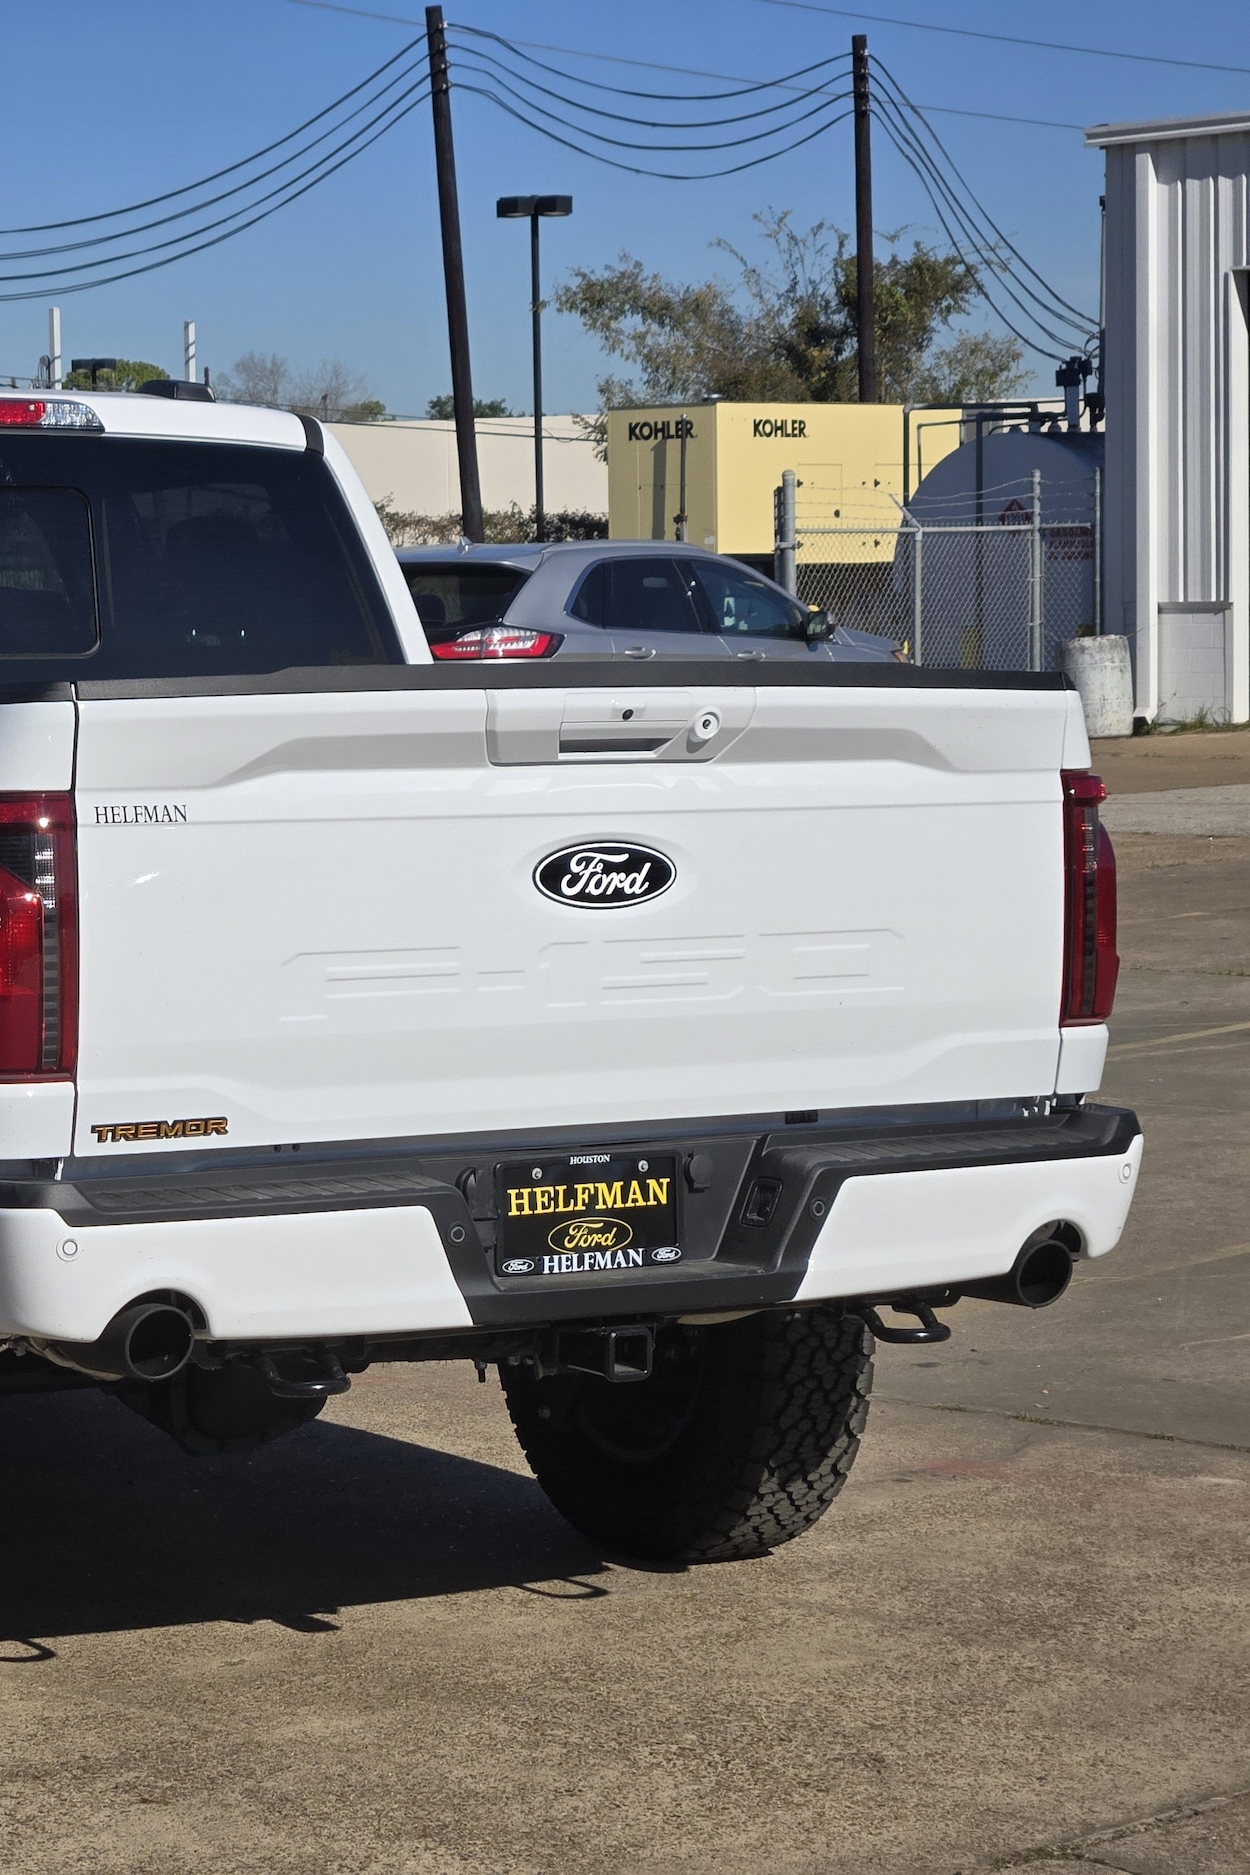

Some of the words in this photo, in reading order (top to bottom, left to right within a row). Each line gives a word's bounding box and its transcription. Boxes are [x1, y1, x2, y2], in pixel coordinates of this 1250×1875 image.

[628, 420, 695, 441] KOHLER
[753, 418, 807, 438] KOHLER
[94, 804, 187, 824] HELFMAN
[560, 851, 652, 896] Ford
[90, 1116, 229, 1144] TREMOR
[569, 1154, 611, 1166] HOUSTON
[506, 1177, 671, 1217] HELFMAN
[563, 1221, 617, 1249] Ford
[542, 1248, 646, 1274] HELFMAN
